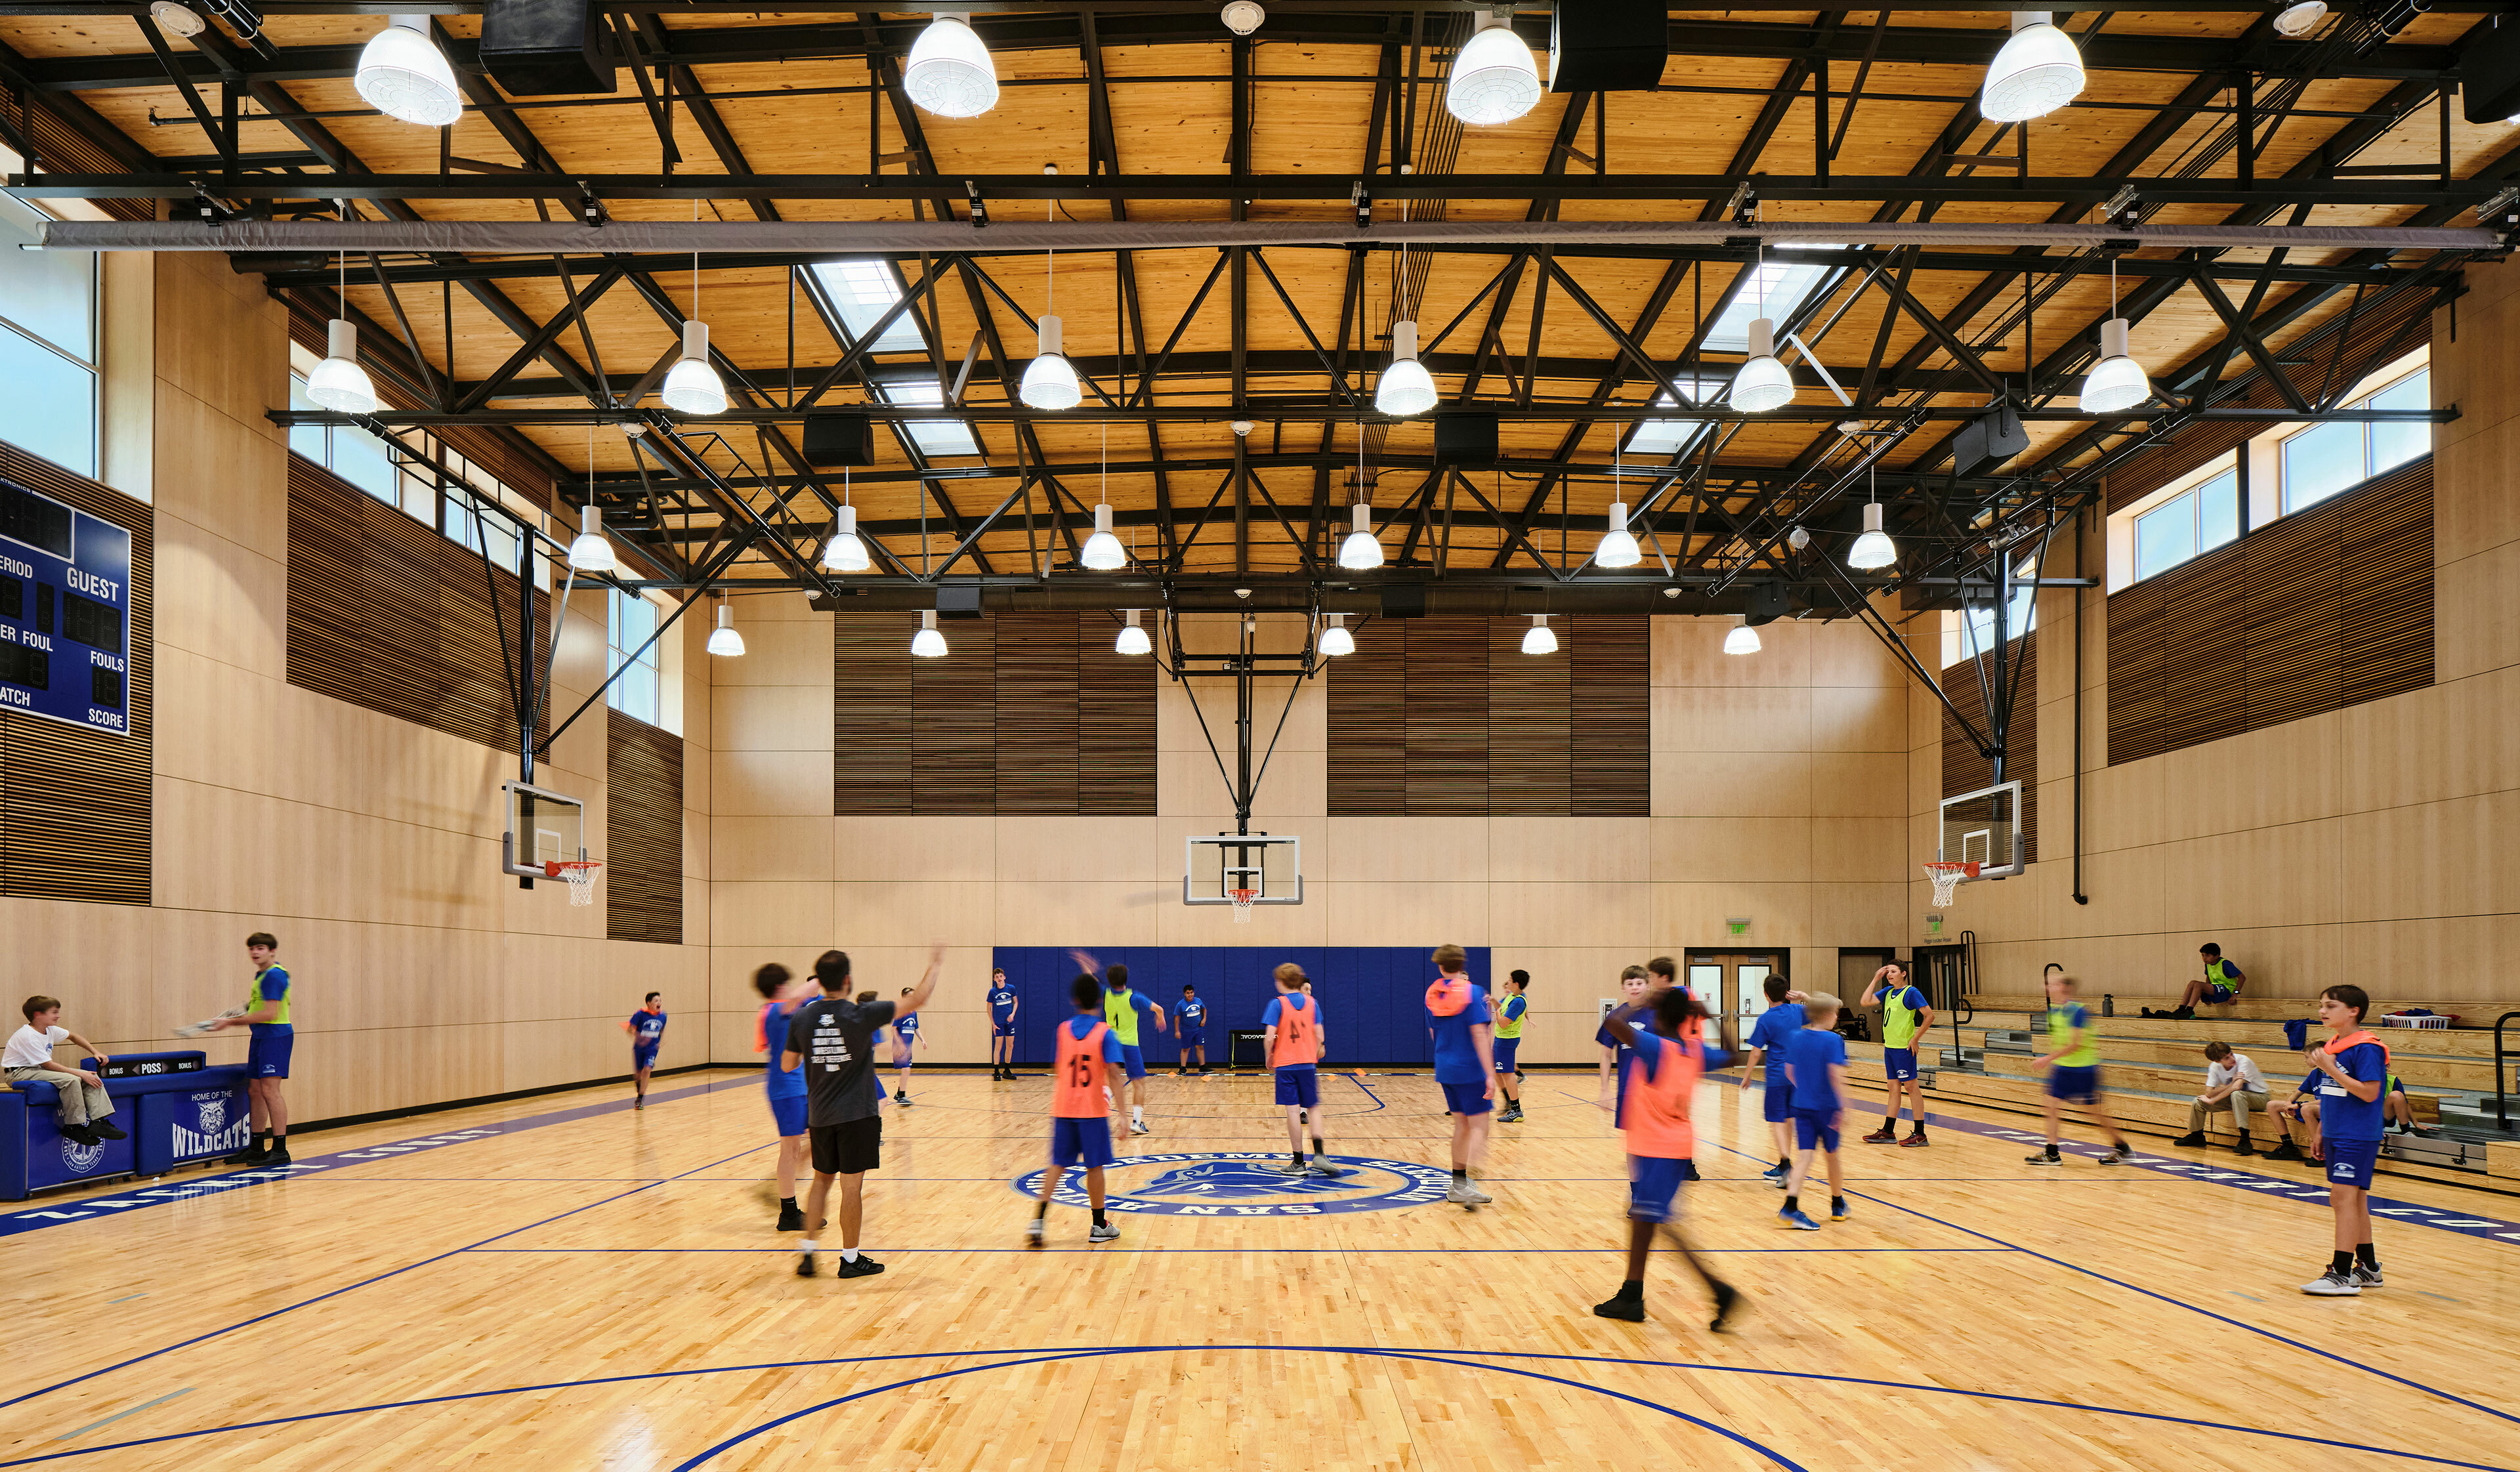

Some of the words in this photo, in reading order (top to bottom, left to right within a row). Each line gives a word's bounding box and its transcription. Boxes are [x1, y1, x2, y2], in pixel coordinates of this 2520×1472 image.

[0, 477, 31, 492] KTRONICS
[67, 567, 119, 601] GUEST
[22, 630, 53, 652] FOUL
[91, 650, 125, 672] FOULS
[89, 707, 123, 728] SCORE
[1732, 924, 1745, 934] EXIT
[141, 1062, 161, 1074] POSS
[1069, 1054, 1092, 1088] 15
[192, 1093, 210, 1102] HOME
[172, 1112, 250, 1158] WILDCATS
[13, 1164, 330, 1219] ZACHRY
[337, 1129, 503, 1158] COURT
[1173, 1204, 1322, 1215] SAN
